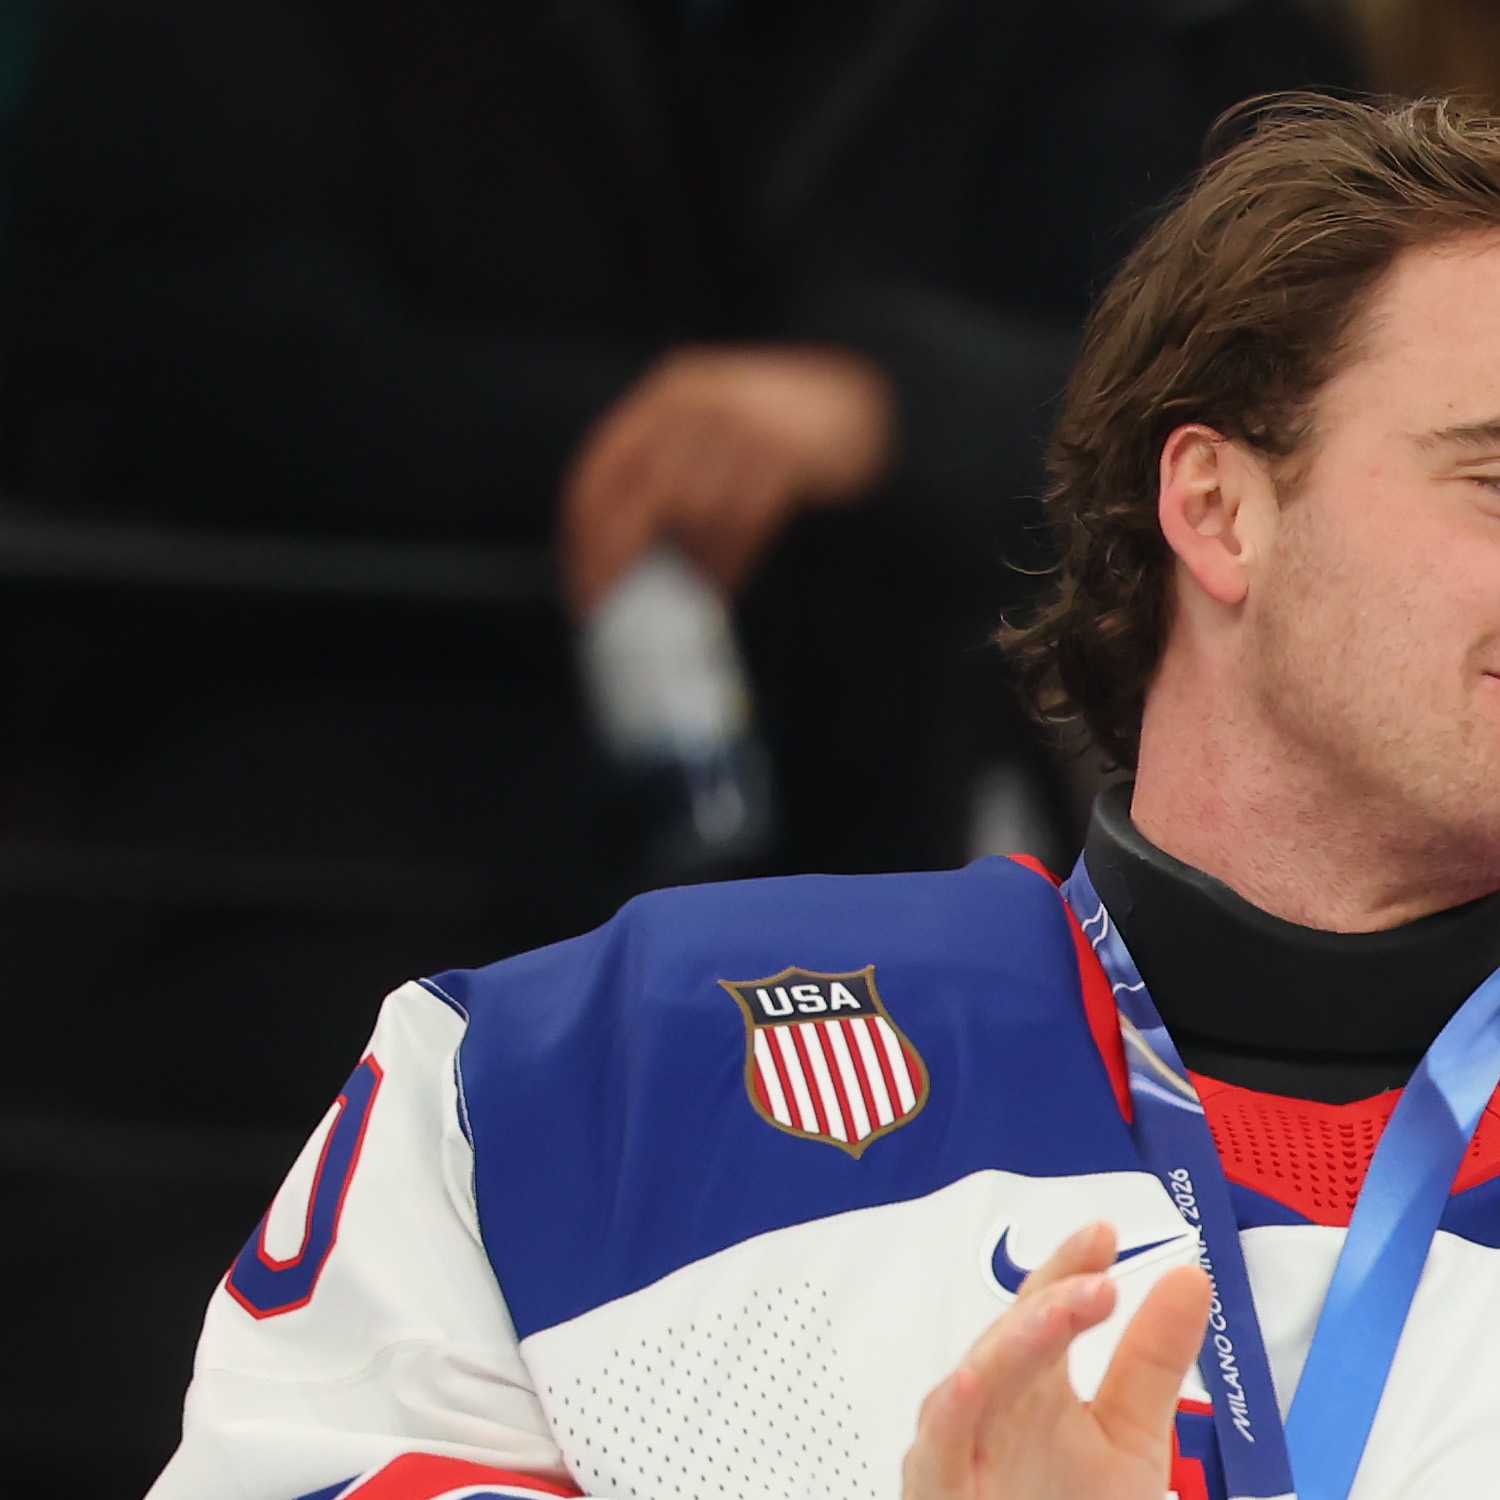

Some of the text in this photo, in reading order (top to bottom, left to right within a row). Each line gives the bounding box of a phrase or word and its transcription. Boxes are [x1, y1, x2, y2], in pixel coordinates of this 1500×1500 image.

[755, 981, 862, 1017] USA
[1167, 1168, 1201, 1221] 2026
[1213, 1333, 1256, 1443] MILANO
